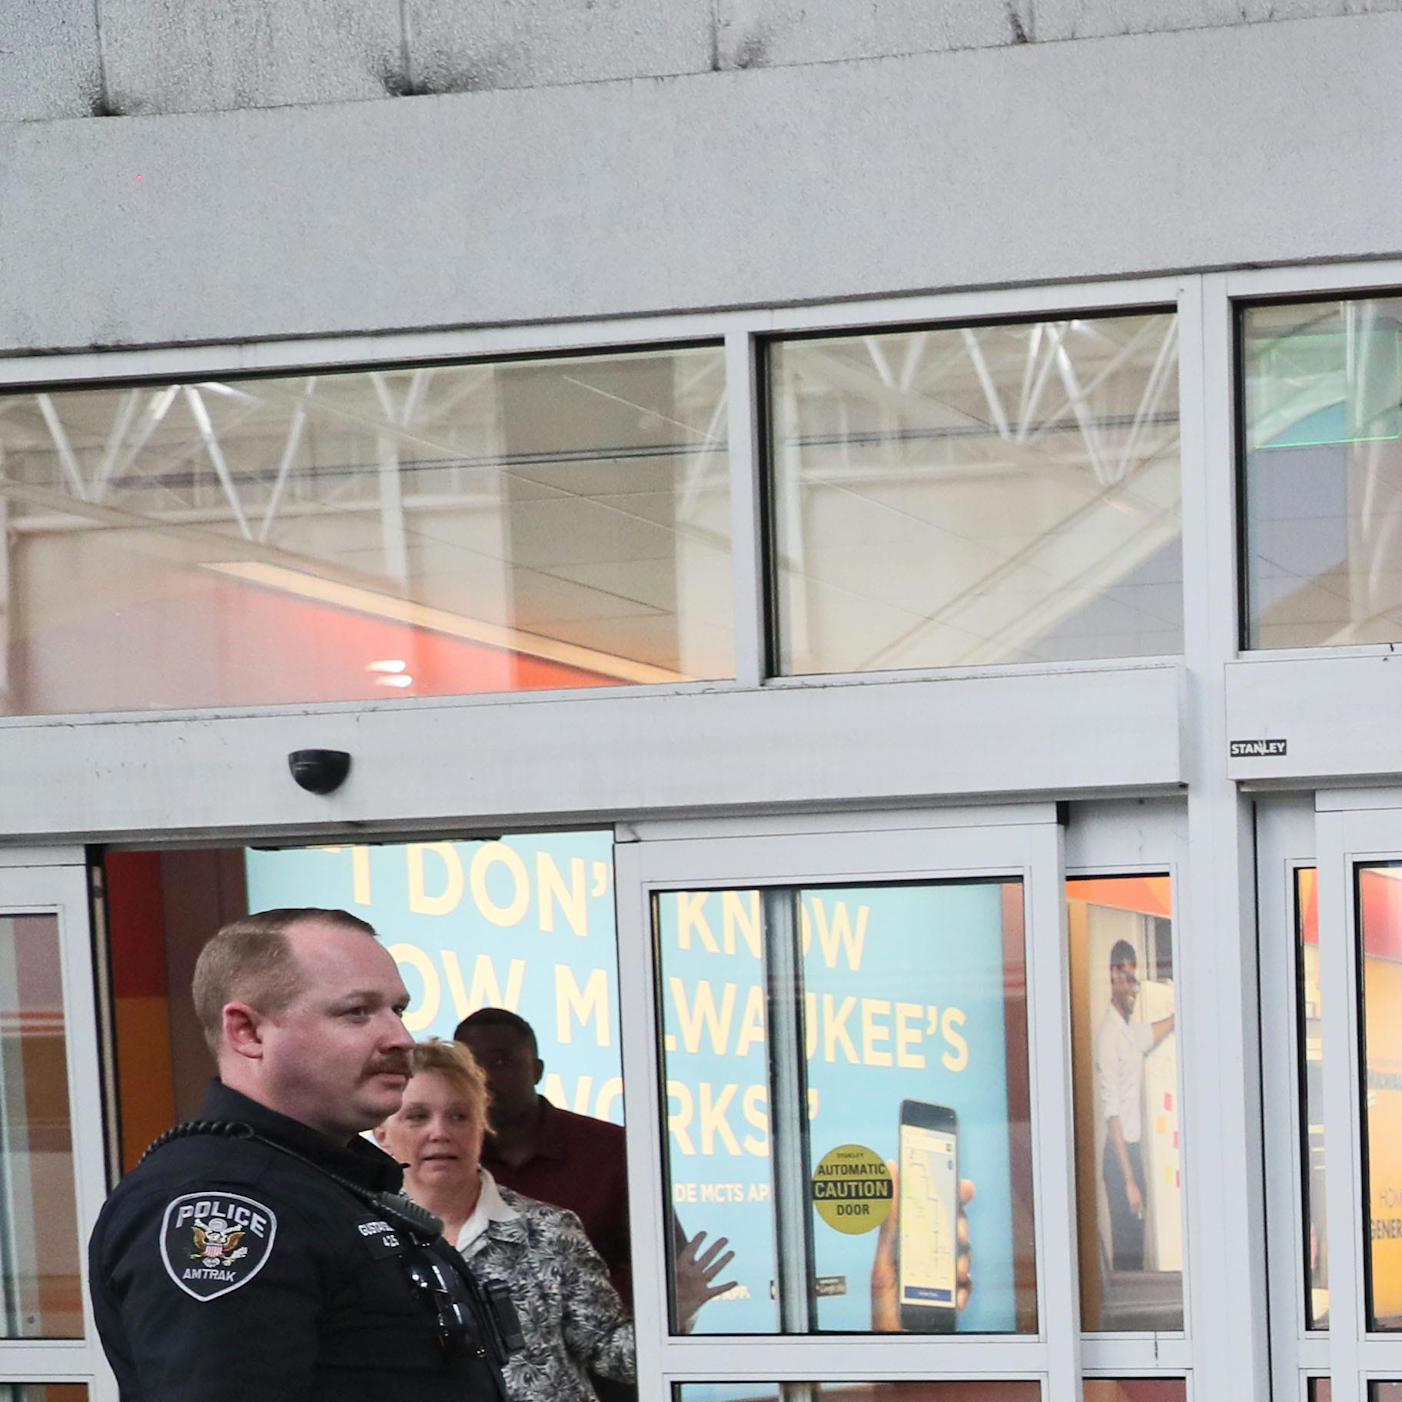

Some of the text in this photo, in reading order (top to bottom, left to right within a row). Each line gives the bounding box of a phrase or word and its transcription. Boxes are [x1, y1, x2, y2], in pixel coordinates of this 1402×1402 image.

[1231, 742, 1285, 755] STANLEY
[406, 840, 612, 937] DON'
[676, 890, 871, 973] KNW
[818, 1163, 886, 1175] AUTOMATIC
[701, 1183, 744, 1202] MCTS
[814, 1181, 888, 1198] CAUTION
[837, 1204, 870, 1215] DOOR
[176, 1201, 267, 1238] POLICE
[182, 1268, 236, 1282] AMTRAK
